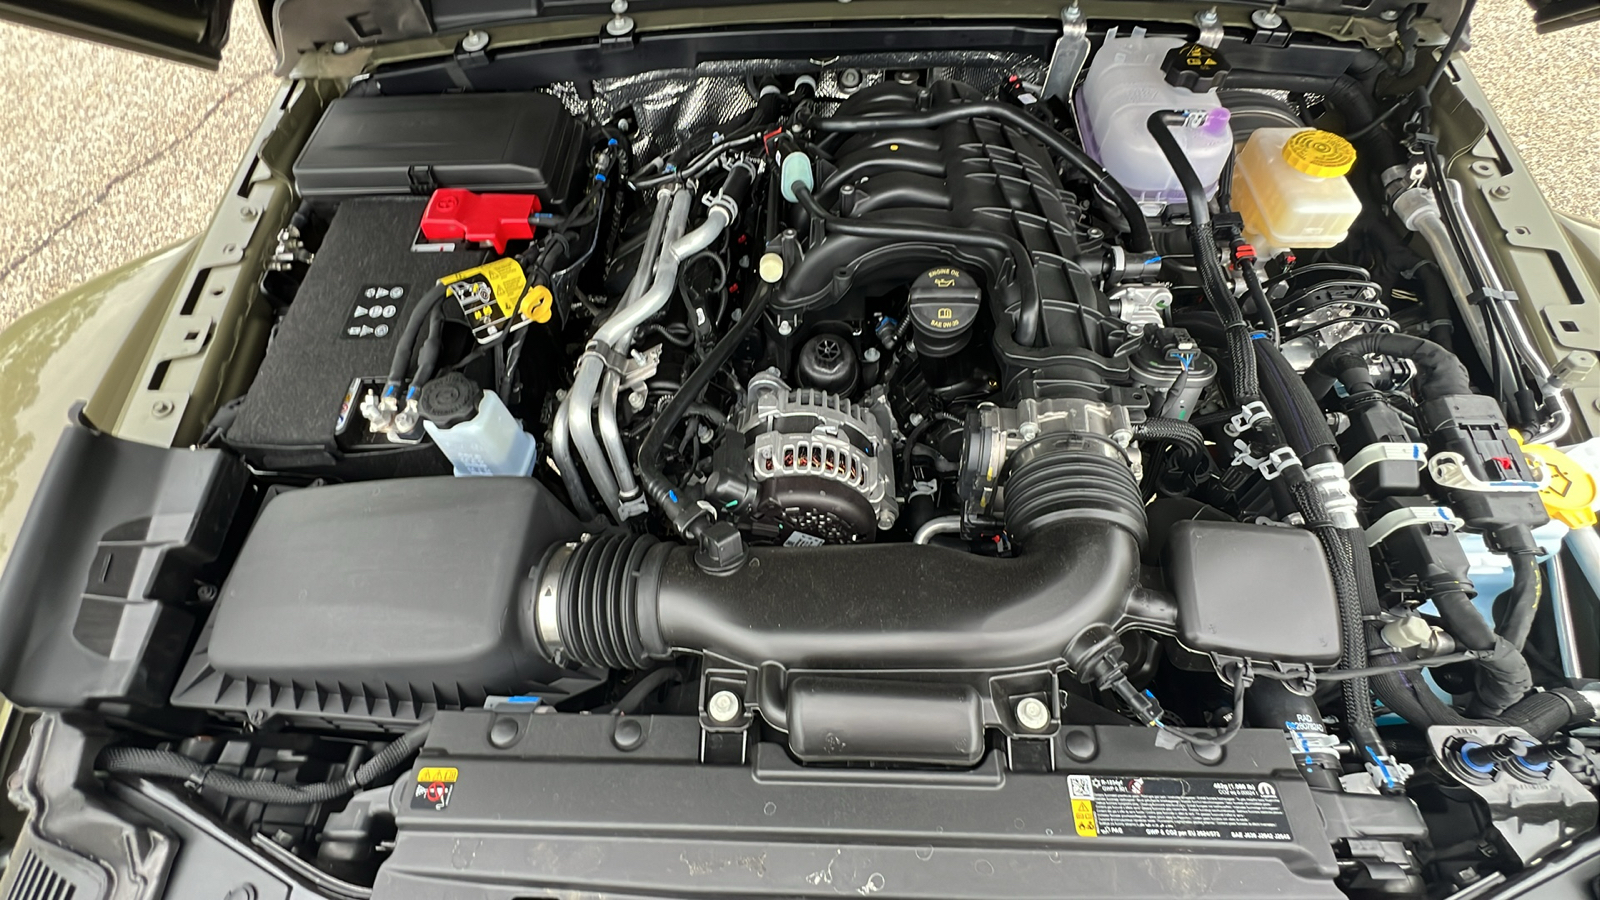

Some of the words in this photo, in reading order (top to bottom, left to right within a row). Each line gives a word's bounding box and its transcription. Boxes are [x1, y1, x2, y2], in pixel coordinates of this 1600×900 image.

[928, 269, 950, 278] ENGINE
[951, 269, 960, 278] OIL
[931, 319, 942, 328] SAE
[1296, 713, 1313, 722] RAD
[1187, 830, 1197, 838] EU
[1230, 831, 1244, 839] SAE
